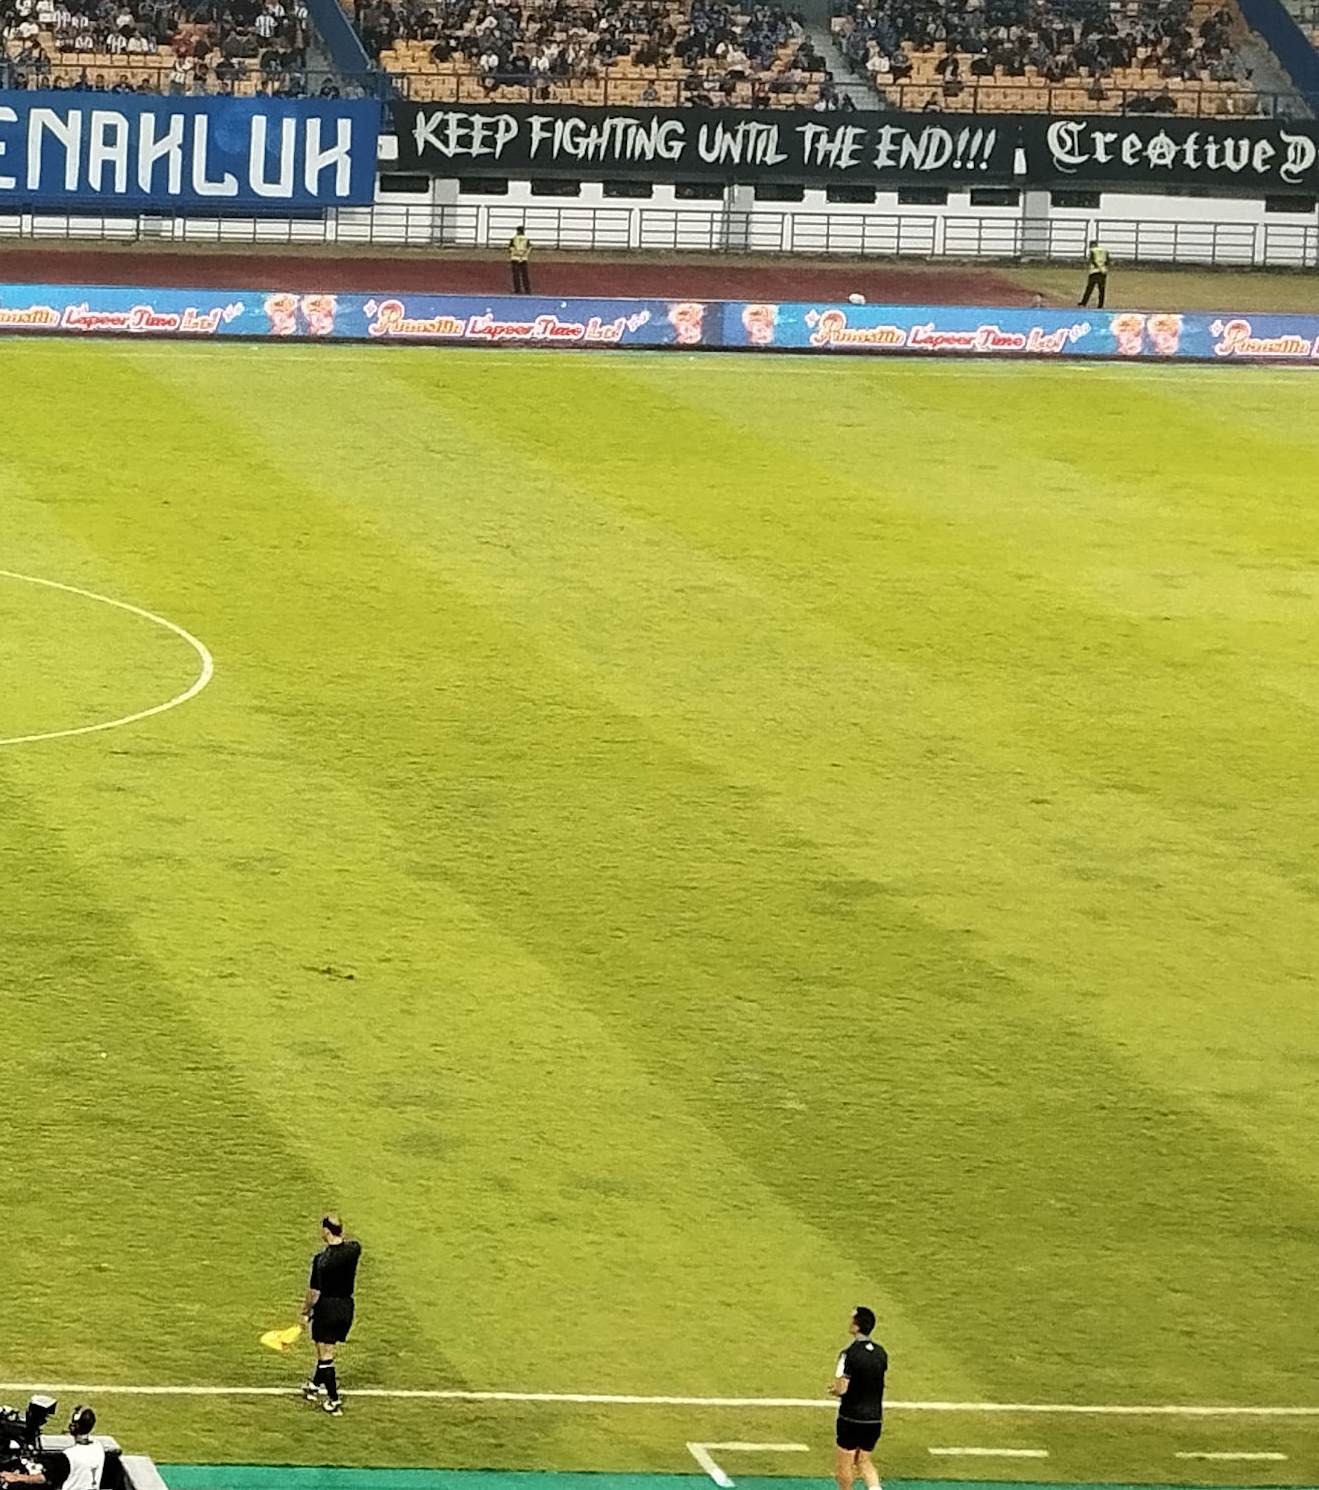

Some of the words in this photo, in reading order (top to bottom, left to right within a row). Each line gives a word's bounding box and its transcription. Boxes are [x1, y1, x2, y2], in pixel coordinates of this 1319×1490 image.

[413, 110, 519, 159] KEEP
[527, 116, 686, 162] FIGHTING
[698, 120, 788, 166] UNTIL
[796, 122, 868, 170] THE
[873, 124, 998, 172] END!!!
